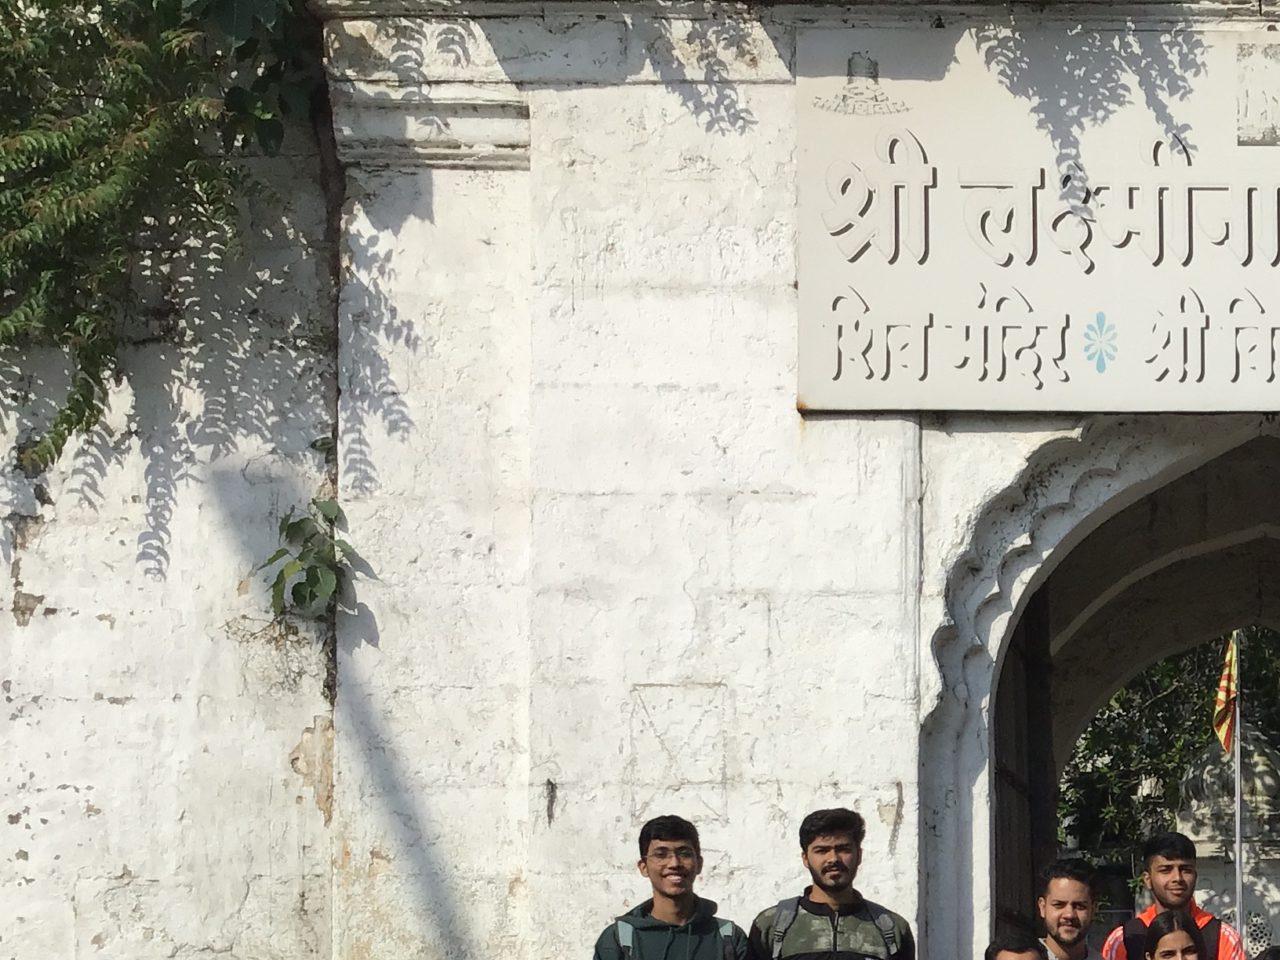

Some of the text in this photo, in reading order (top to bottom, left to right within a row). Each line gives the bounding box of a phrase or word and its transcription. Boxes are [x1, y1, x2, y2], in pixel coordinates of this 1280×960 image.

[821, 125, 938, 266] श्री
[942, 281, 1071, 391] मंदिर
[1143, 284, 1210, 384] श्री
